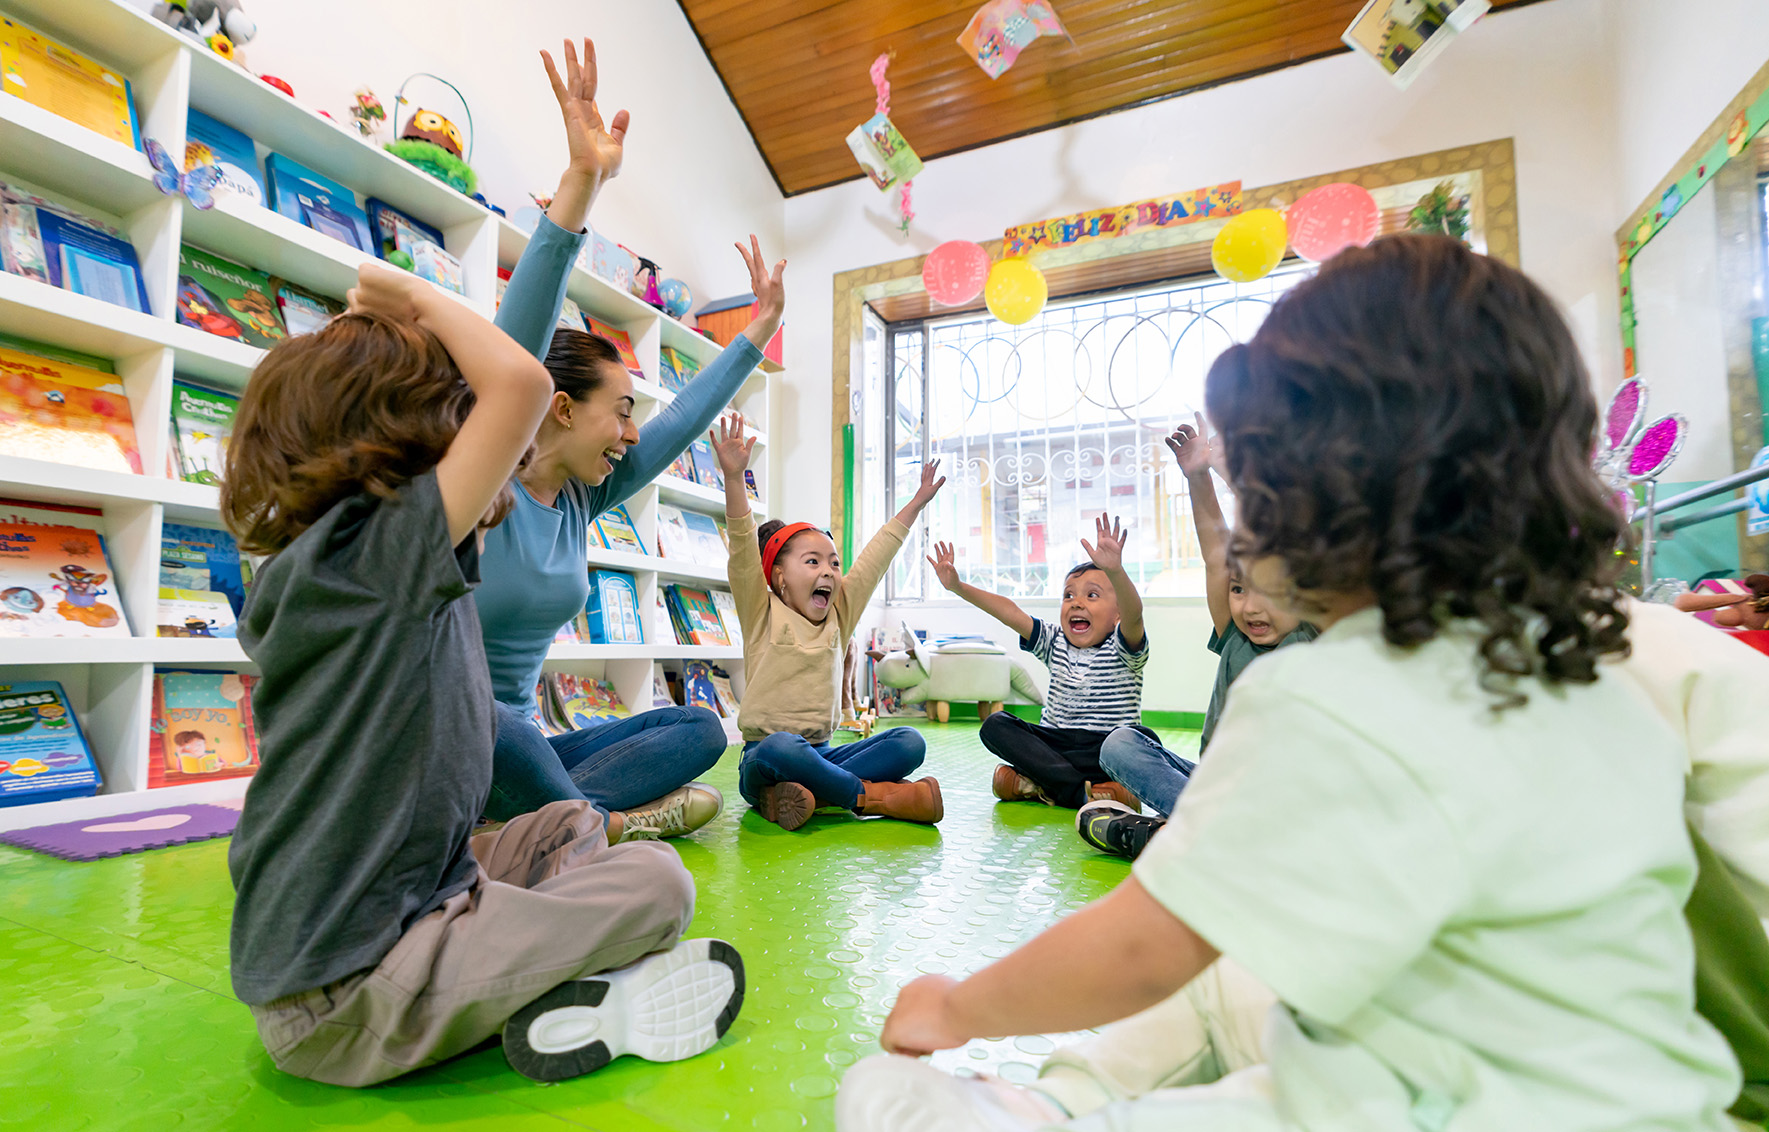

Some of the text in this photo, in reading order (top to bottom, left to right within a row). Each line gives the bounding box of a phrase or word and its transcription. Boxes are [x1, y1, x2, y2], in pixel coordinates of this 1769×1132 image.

[1049, 213, 1116, 244] FELIZ
[191, 259, 263, 293] ruiseñor
[171, 708, 203, 722] soy
